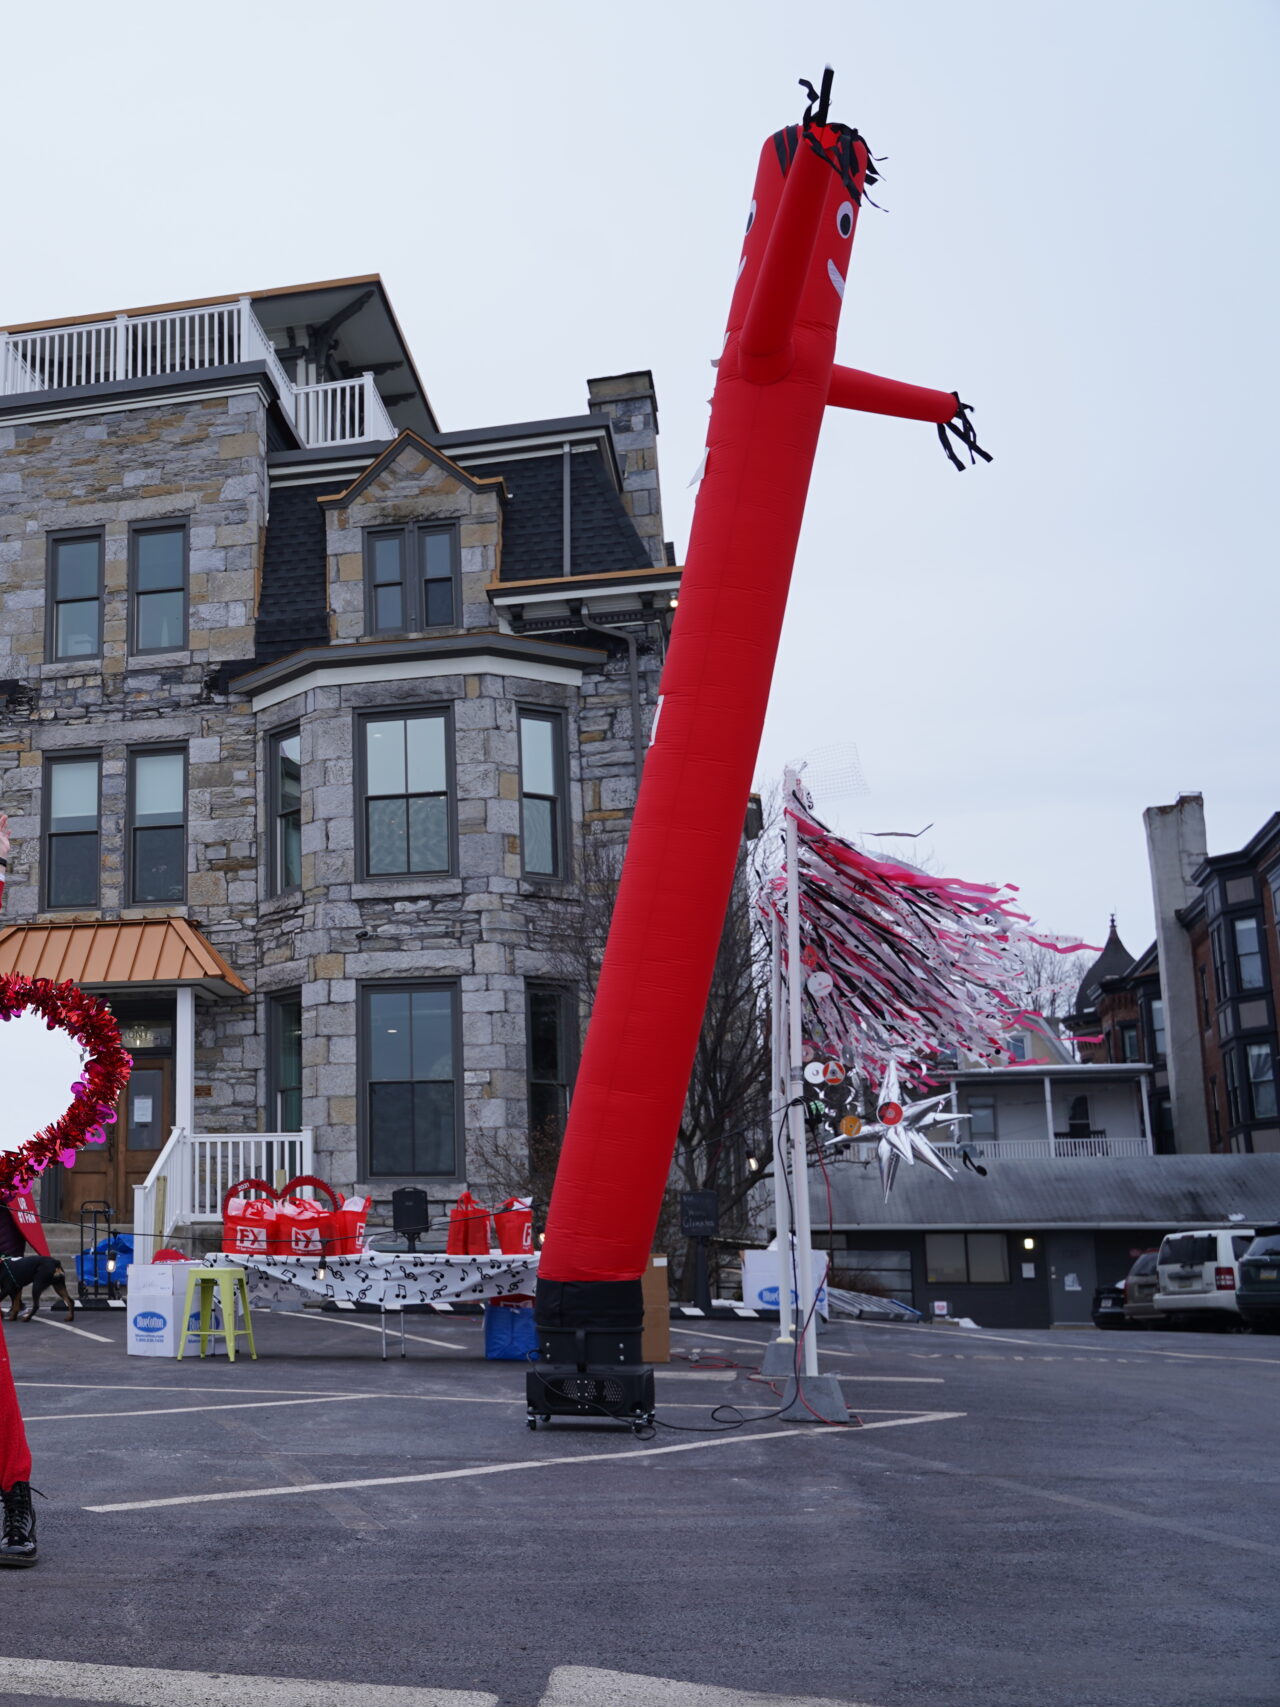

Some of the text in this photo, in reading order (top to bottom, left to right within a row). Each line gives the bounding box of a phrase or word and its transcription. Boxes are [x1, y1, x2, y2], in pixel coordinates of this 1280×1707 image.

[237, 1182, 250, 1191] 2021
[239, 1228, 266, 1248] FX
[294, 1230, 319, 1248] FX
[136, 1316, 164, 1329] BlueCotton
